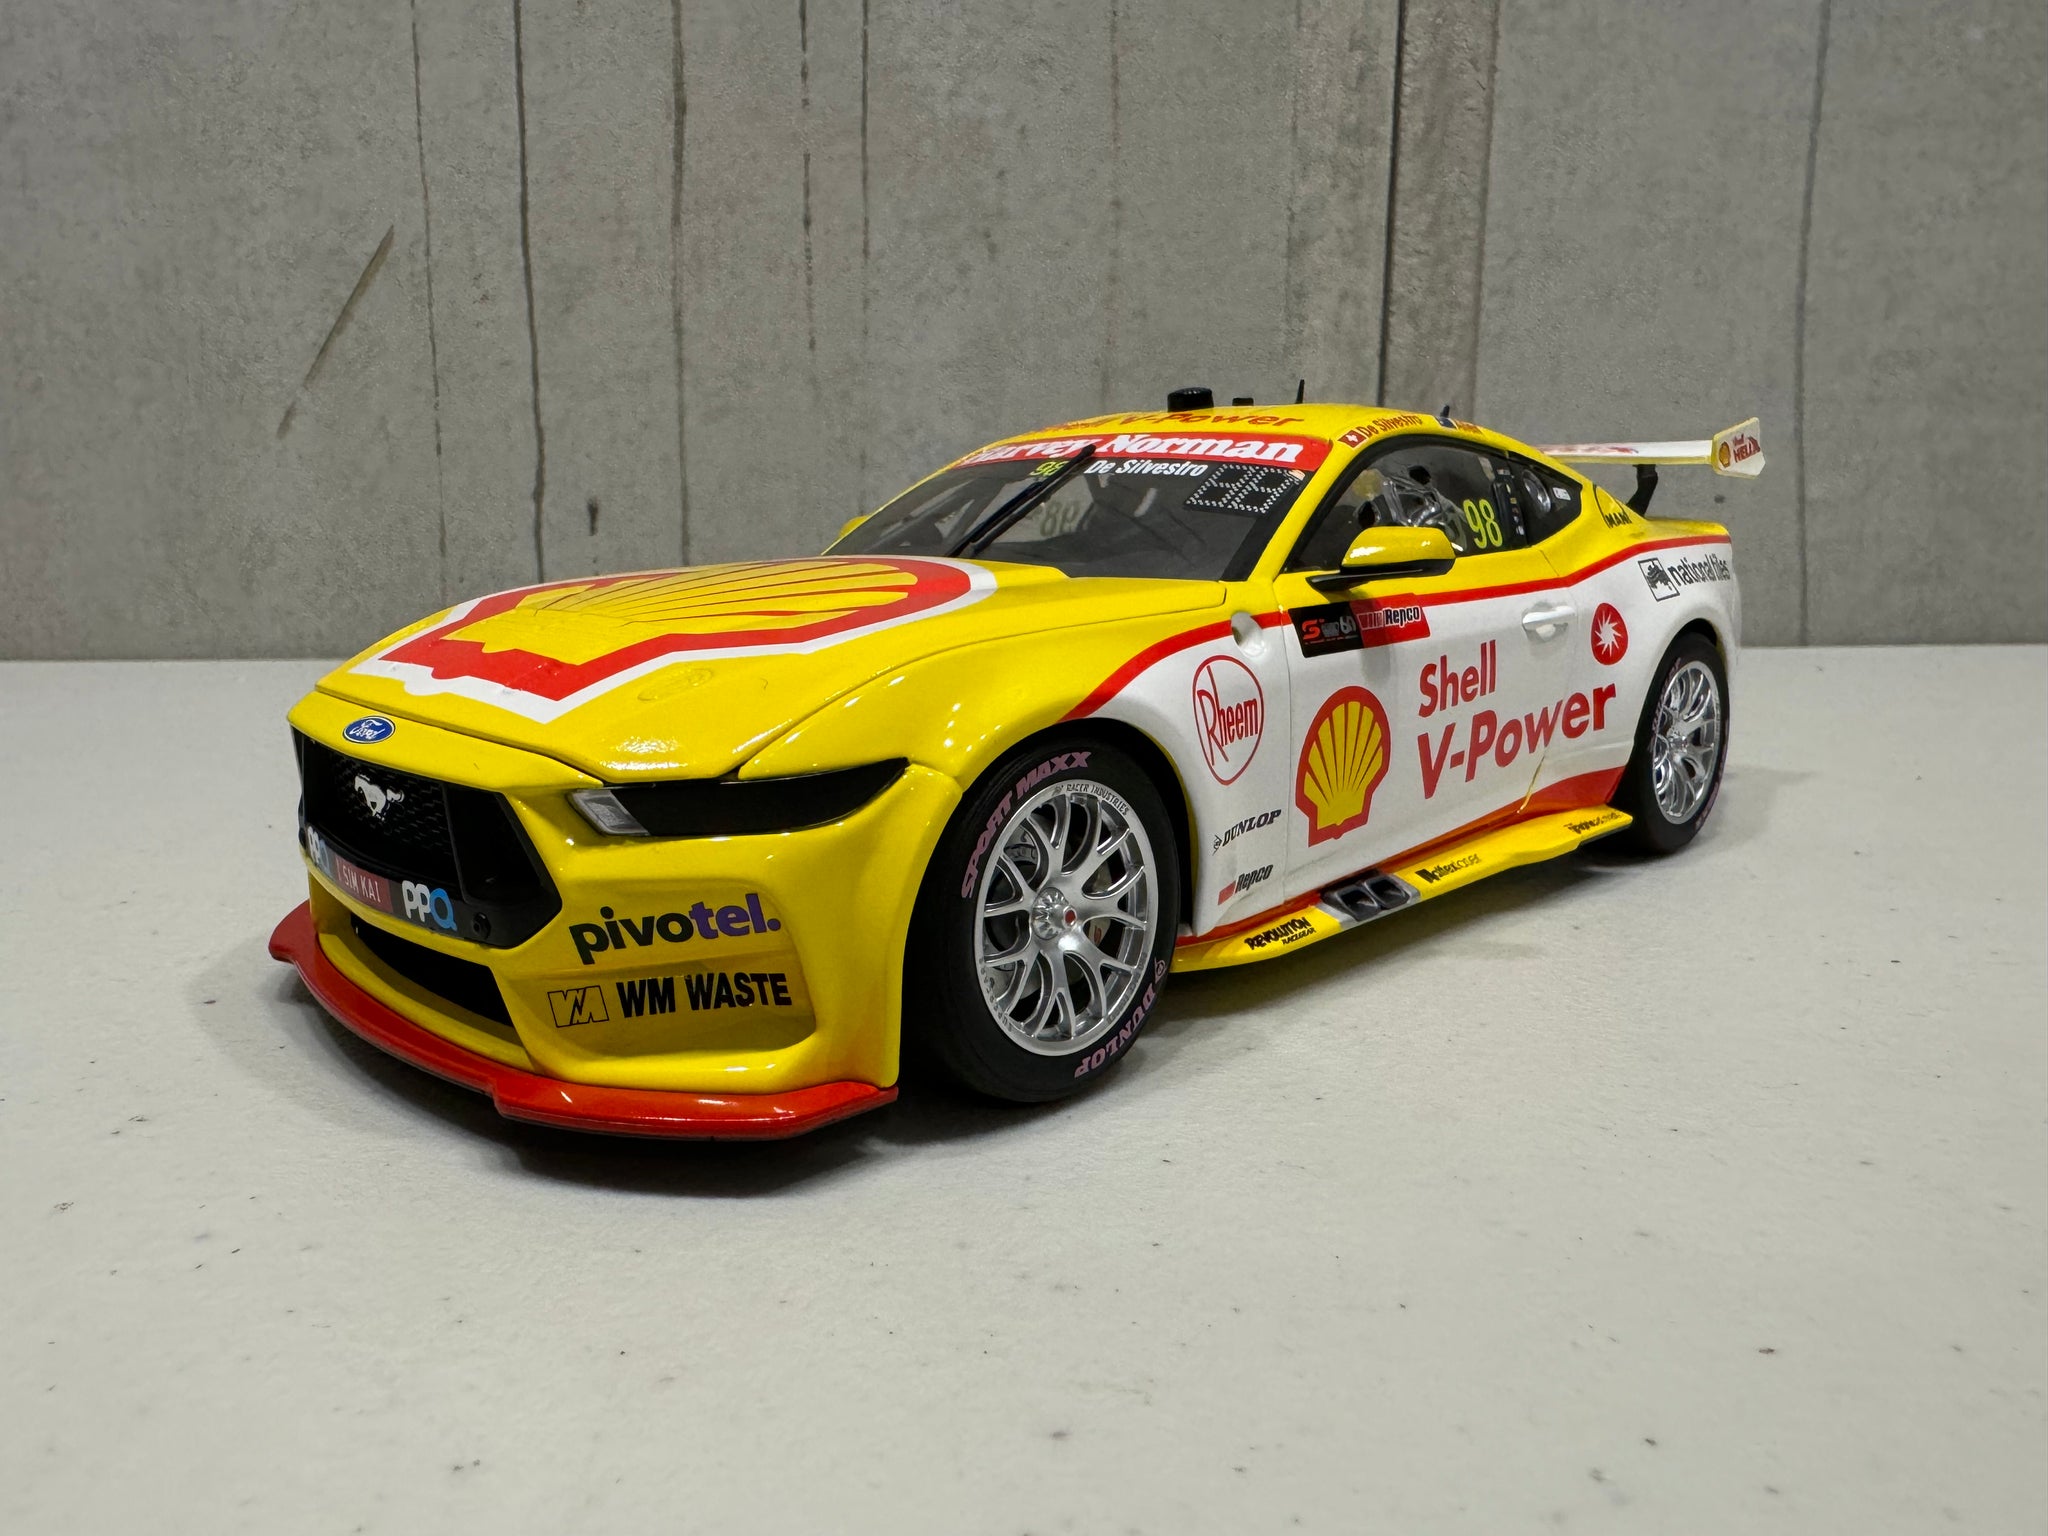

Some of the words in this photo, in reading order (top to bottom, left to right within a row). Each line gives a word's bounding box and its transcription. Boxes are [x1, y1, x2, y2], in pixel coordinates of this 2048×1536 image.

[1084, 459, 1112, 474] De
[1115, 459, 1209, 477] Silvestro
[1097, 434, 1304, 464] Norman
[1463, 498, 1503, 549] 98
[1384, 606, 1420, 628] Repco
[1418, 639, 1497, 719] Shell
[1197, 665, 1259, 766] Rheem
[1416, 683, 1617, 800] V-Power
[961, 790, 1013, 898] SPORT
[1016, 751, 1092, 799] MAXX
[1222, 809, 1282, 847] DUNLOP
[360, 875, 381, 903] KAI
[1235, 864, 1274, 893] Repco
[402, 880, 458, 932] PPQ
[568, 893, 781, 965] pivotel.
[1244, 916, 1312, 950] REVOLUTION
[616, 976, 676, 1018] WM
[685, 972, 792, 1011] WASTE
[1074, 983, 1156, 1078] DUNLOP
